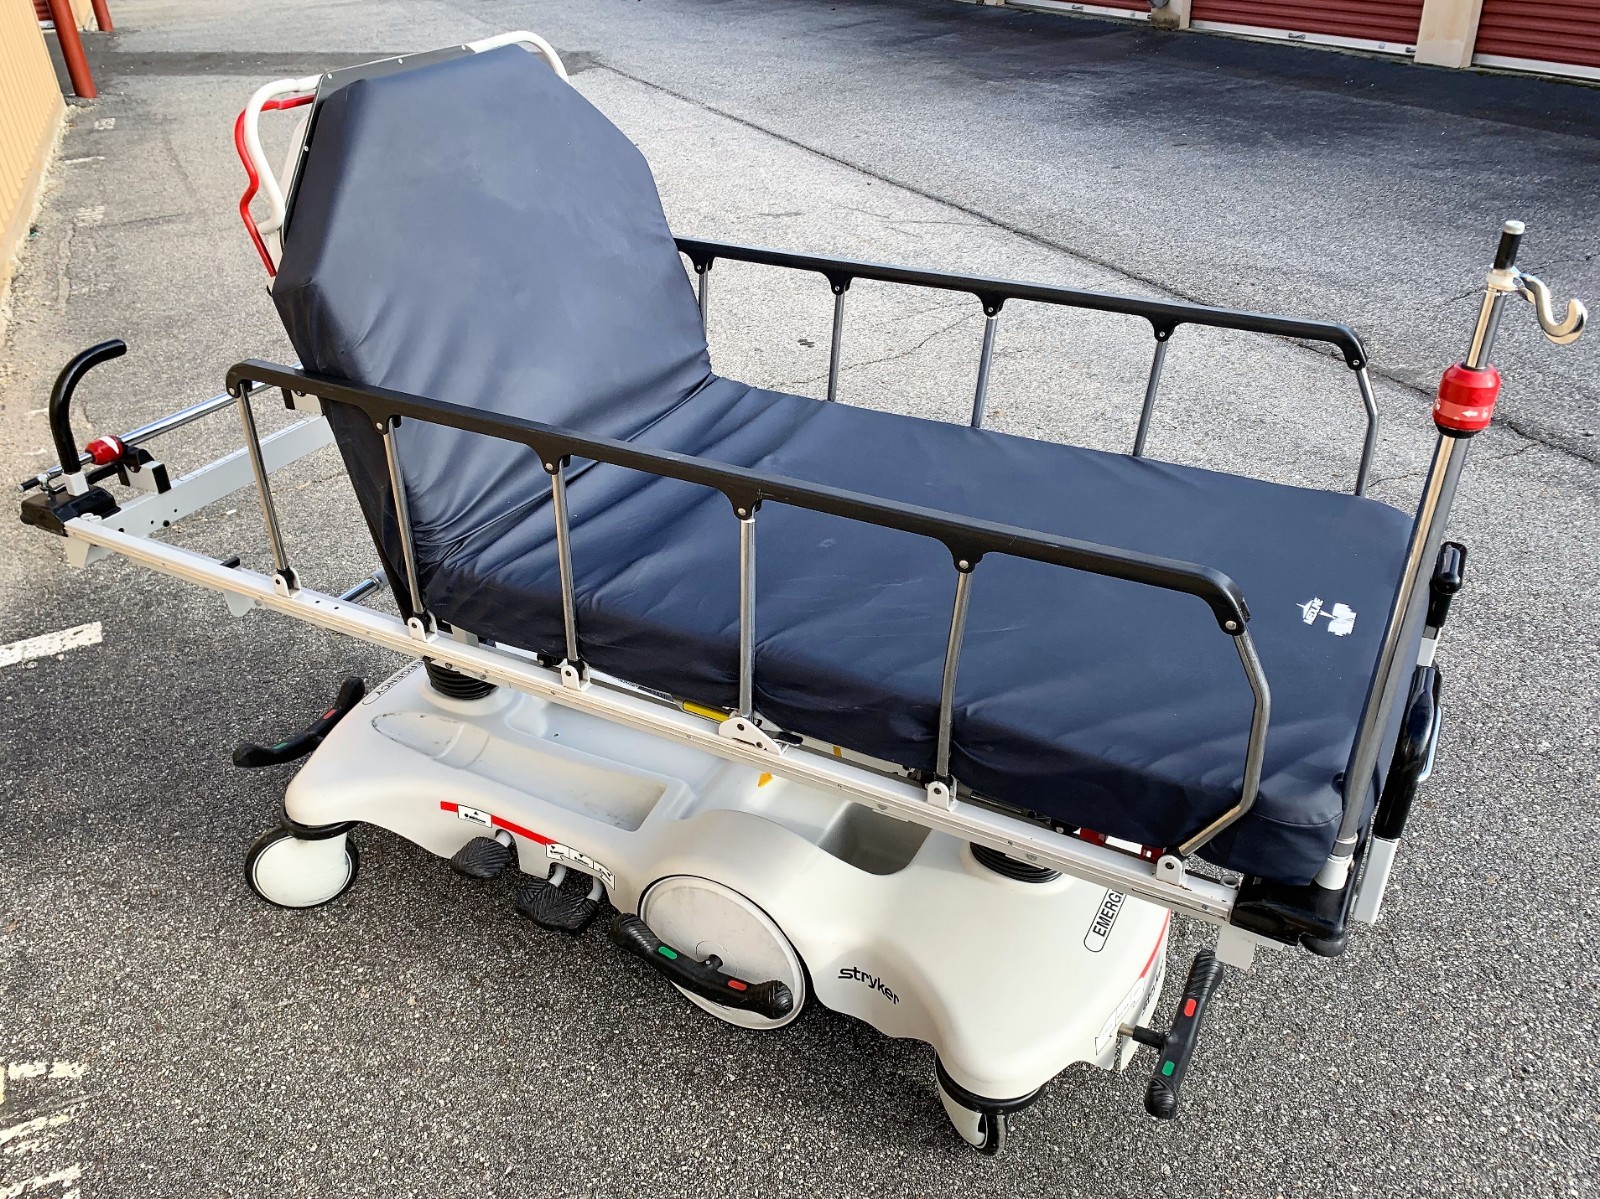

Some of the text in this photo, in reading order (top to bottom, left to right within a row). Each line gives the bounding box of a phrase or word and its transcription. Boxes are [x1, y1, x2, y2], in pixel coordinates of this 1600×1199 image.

[1303, 597, 1323, 625] MEDLINE
[1093, 890, 1124, 937] EMERG
[838, 966, 900, 1005] stryker
